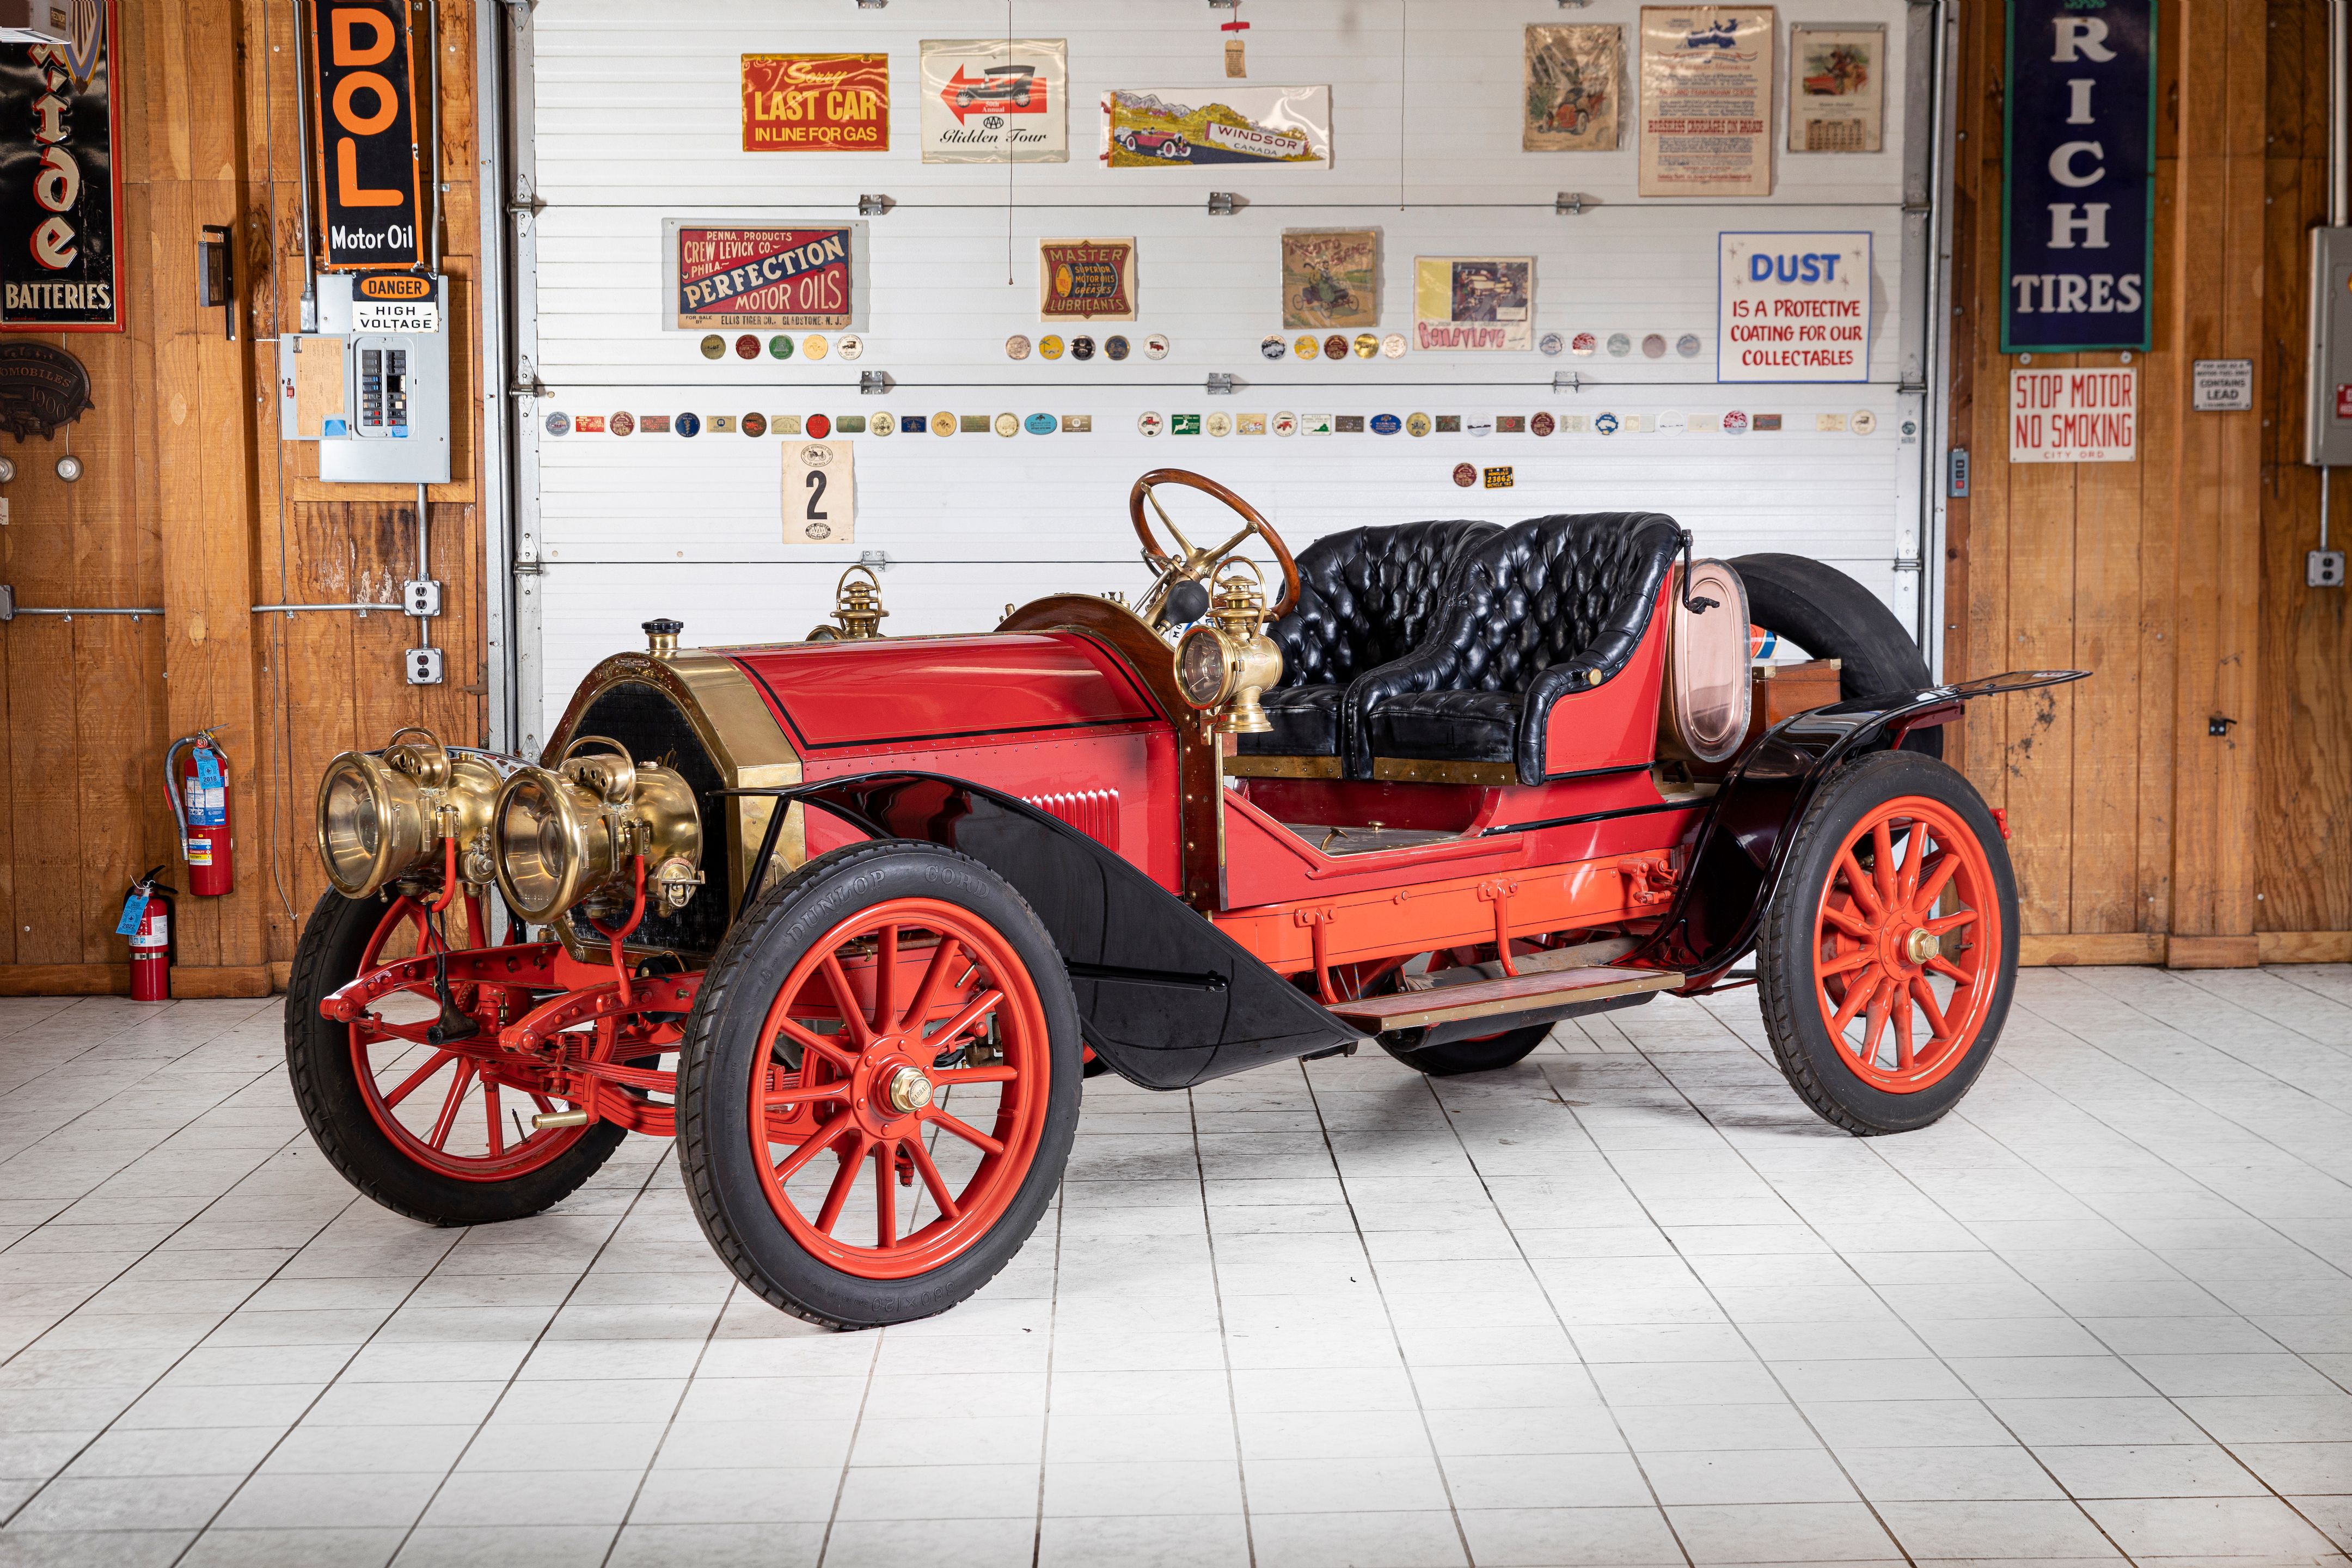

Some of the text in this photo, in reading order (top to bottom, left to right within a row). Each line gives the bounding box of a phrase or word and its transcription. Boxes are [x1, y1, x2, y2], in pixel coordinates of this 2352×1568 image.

[784, 63, 848, 90] Sorry
[755, 91, 877, 120] LAST CAR
[984, 116, 1004, 129] AAA
[755, 127, 877, 142] IN LINE FOR GAS
[940, 128, 1048, 144] Glidden Tour
[1218, 126, 1297, 150] WINDSOR
[1234, 143, 1277, 156] CANADA
[332, 224, 413, 249] Motor Oil
[707, 231, 792, 241] PENNA. PRODUCTS
[684, 241, 773, 264] CREW LEVICK CO.
[1050, 249, 1123, 261] MASTER
[683, 236, 846, 309] PERFECTION
[691, 261, 723, 278] PHILA.
[1751, 253, 1841, 283] DUST
[369, 280, 422, 295] DANGER
[1100, 275, 1115, 283] OILS
[5, 284, 111, 309] BATTERIES
[735, 270, 841, 310] MOTOR OILS
[2012, 274, 2142, 313] TIRES
[376, 307, 415, 315] HIGH
[1050, 299, 1124, 311] LUBRICANTS
[1733, 299, 1860, 317] IS A PROTECTIVE
[360, 319, 431, 328] VOLTAGE
[721, 316, 739, 325] ELLIS
[743, 316, 761, 325] TIGER
[1730, 325, 1863, 342] COATING FOR OUR
[1742, 350, 1853, 366] COLLECTABLES
[2017, 373, 2132, 408] STOP MOTOR
[2206, 389, 2239, 400] LEAD
[32, 385, 66, 420] 1900
[2016, 413, 2132, 448] NO SMOKING
[2043, 451, 2071, 459] CITY
[806, 470, 828, 520] 2
[786, 865, 990, 946] DUNLOP CORD
[727, 1061, 737, 1102] ENGLAND
